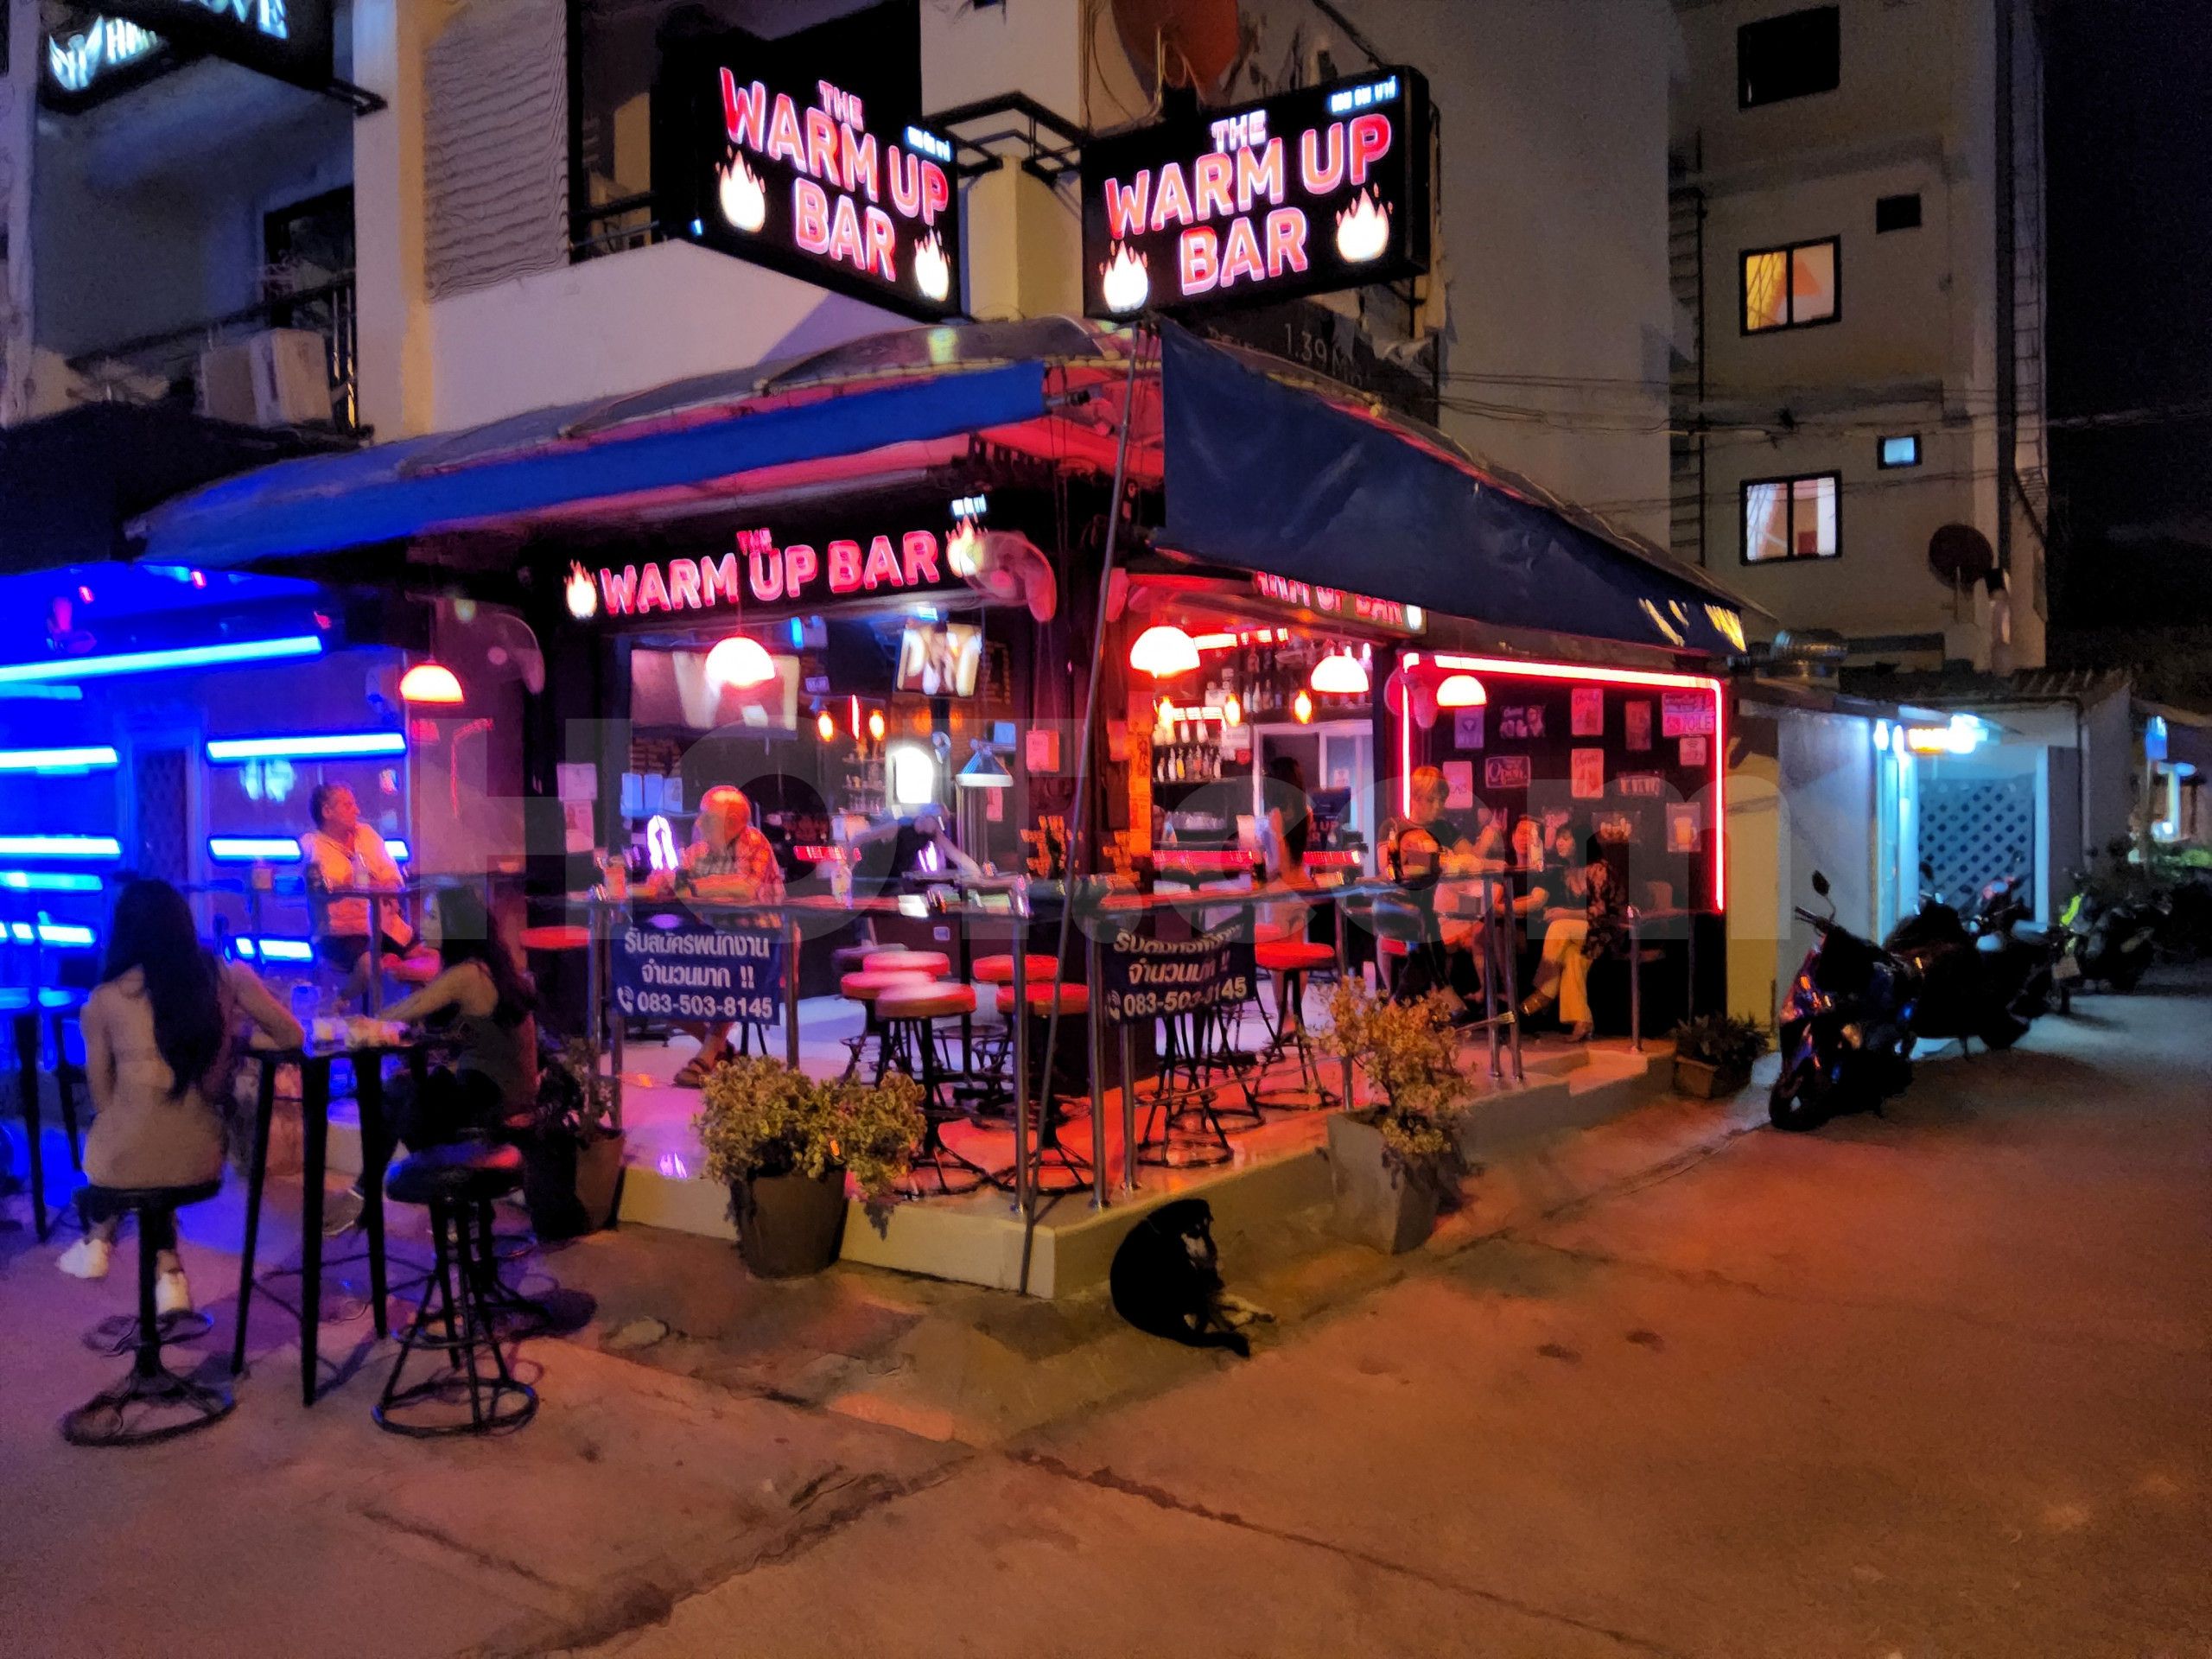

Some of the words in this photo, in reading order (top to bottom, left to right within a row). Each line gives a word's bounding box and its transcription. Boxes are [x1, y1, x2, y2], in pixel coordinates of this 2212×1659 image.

[818, 79, 863, 131] THE
[1211, 110, 1267, 151] THE
[720, 67, 879, 203] WARM
[887, 145, 949, 226] UP
[1104, 137, 1285, 239] WARM
[1302, 113, 1391, 194] UP
[795, 177, 896, 282] BAR
[1180, 207, 1308, 296] BAR
[600, 552, 740, 615] WARM
[749, 543, 818, 601] UP
[828, 530, 941, 594] BAR
[736, 528, 772, 556] THE
[637, 992, 772, 1018] 083-503-8145
[641, 958, 731, 988] จำนวนมาก
